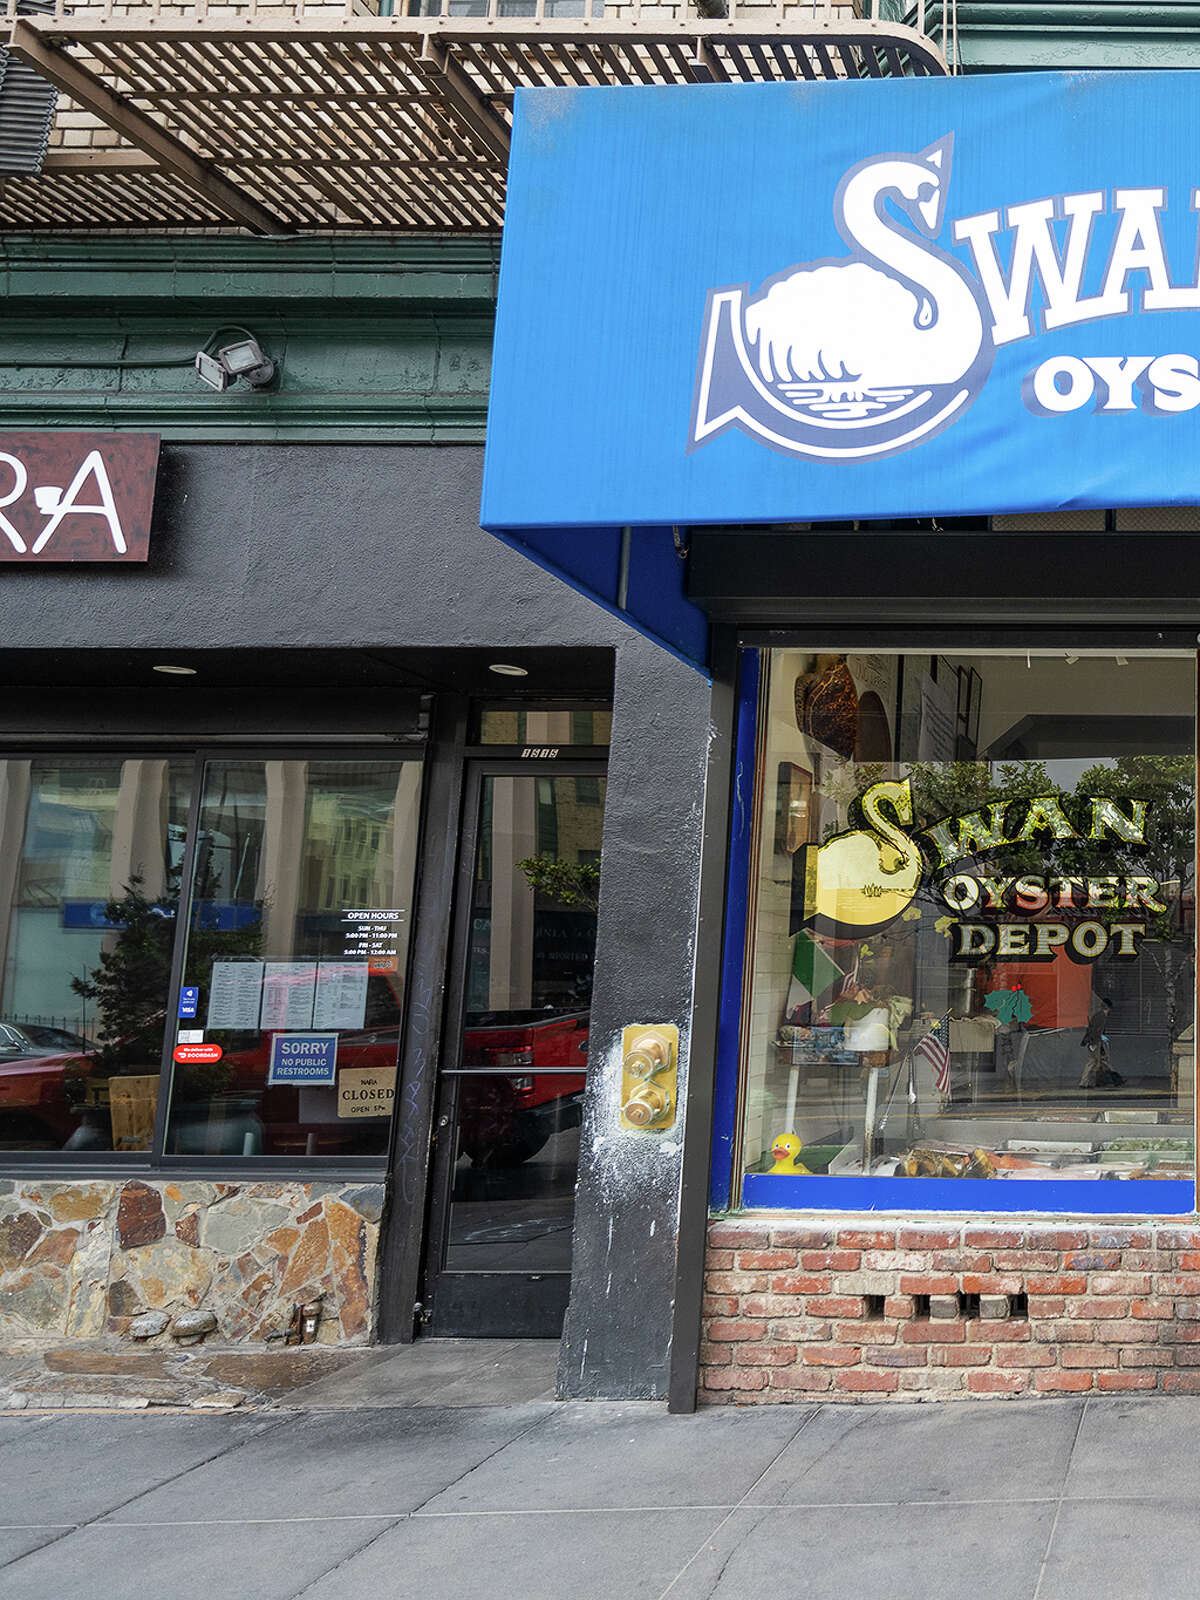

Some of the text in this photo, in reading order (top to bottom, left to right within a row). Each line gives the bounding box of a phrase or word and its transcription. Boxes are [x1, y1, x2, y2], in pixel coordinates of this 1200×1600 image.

[812, 779, 1148, 908] SWAN
[942, 875, 1168, 914] OYSTER
[955, 921, 1146, 957] DEPOT
[281, 1042, 329, 1055] SORRY
[281, 1058, 327, 1066] NO PUBLIC
[277, 1067, 329, 1076] RESTROOMS
[342, 1088, 395, 1101] CLOSED
